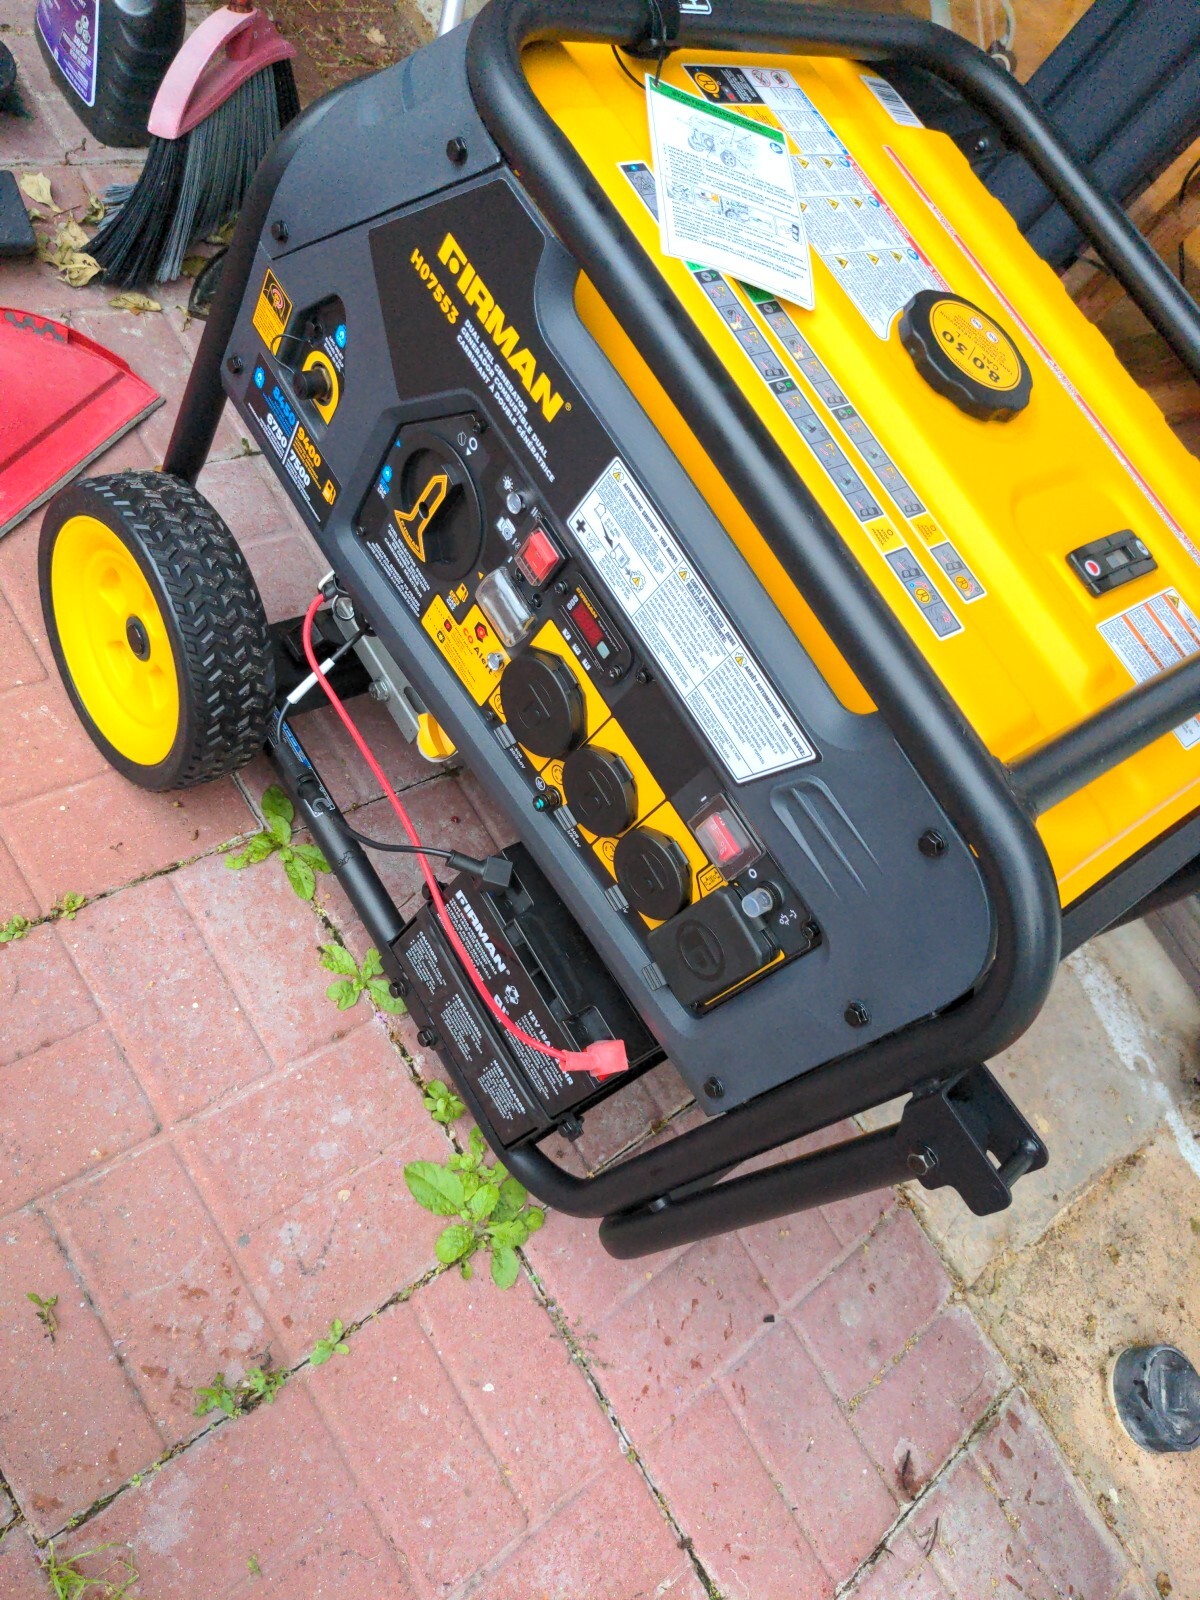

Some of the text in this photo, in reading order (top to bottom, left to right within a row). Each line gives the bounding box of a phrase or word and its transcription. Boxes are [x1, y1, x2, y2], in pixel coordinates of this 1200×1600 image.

[408, 246, 460, 327] H07553
[436, 229, 564, 428] FIRMAN
[464, 318, 527, 415] DUAL FUEL GENERATOR
[980, 353, 999, 372] GAL
[270, 384, 297, 428] 8450
[455, 332, 555, 485] CARBURANT À DOUBLE GÉNÉRATRICE
[460, 325, 548, 459] GENERADOR COMBUSTIBLE DUAL
[264, 410, 288, 450] 6750
[295, 424, 322, 469] 9400
[287, 448, 311, 488] 7500
[462, 625, 474, 645] CO
[453, 888, 508, 976] FIRMAN
[526, 1008, 540, 1030] 12V
